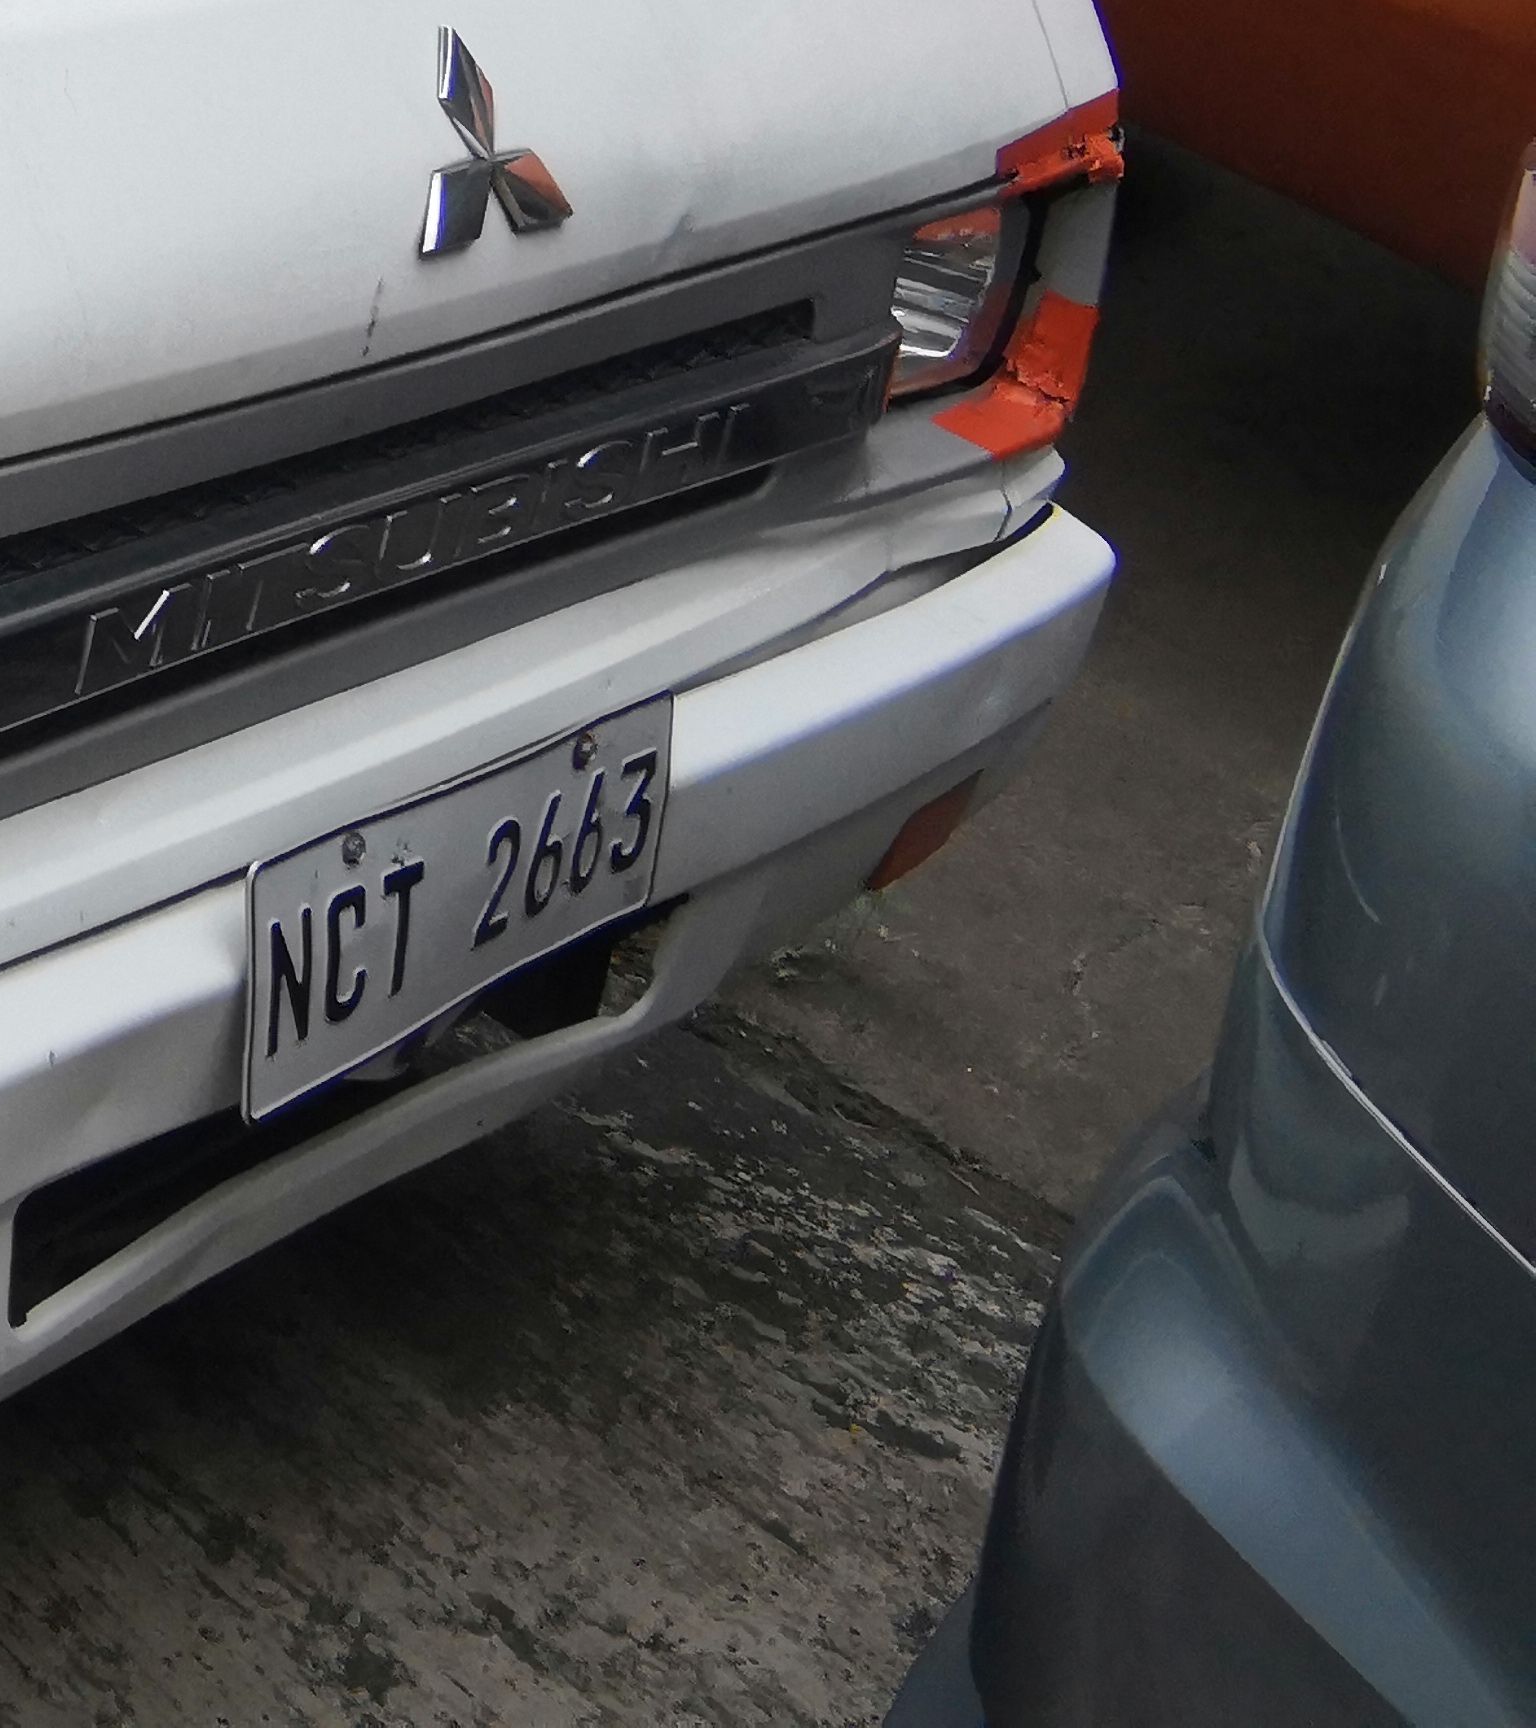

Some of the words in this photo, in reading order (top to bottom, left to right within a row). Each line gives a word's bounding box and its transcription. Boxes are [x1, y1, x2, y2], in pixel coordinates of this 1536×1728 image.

[74, 403, 752, 696] MITSUBISHI
[265, 859, 425, 1060] NCT
[470, 748, 658, 951] 2663
